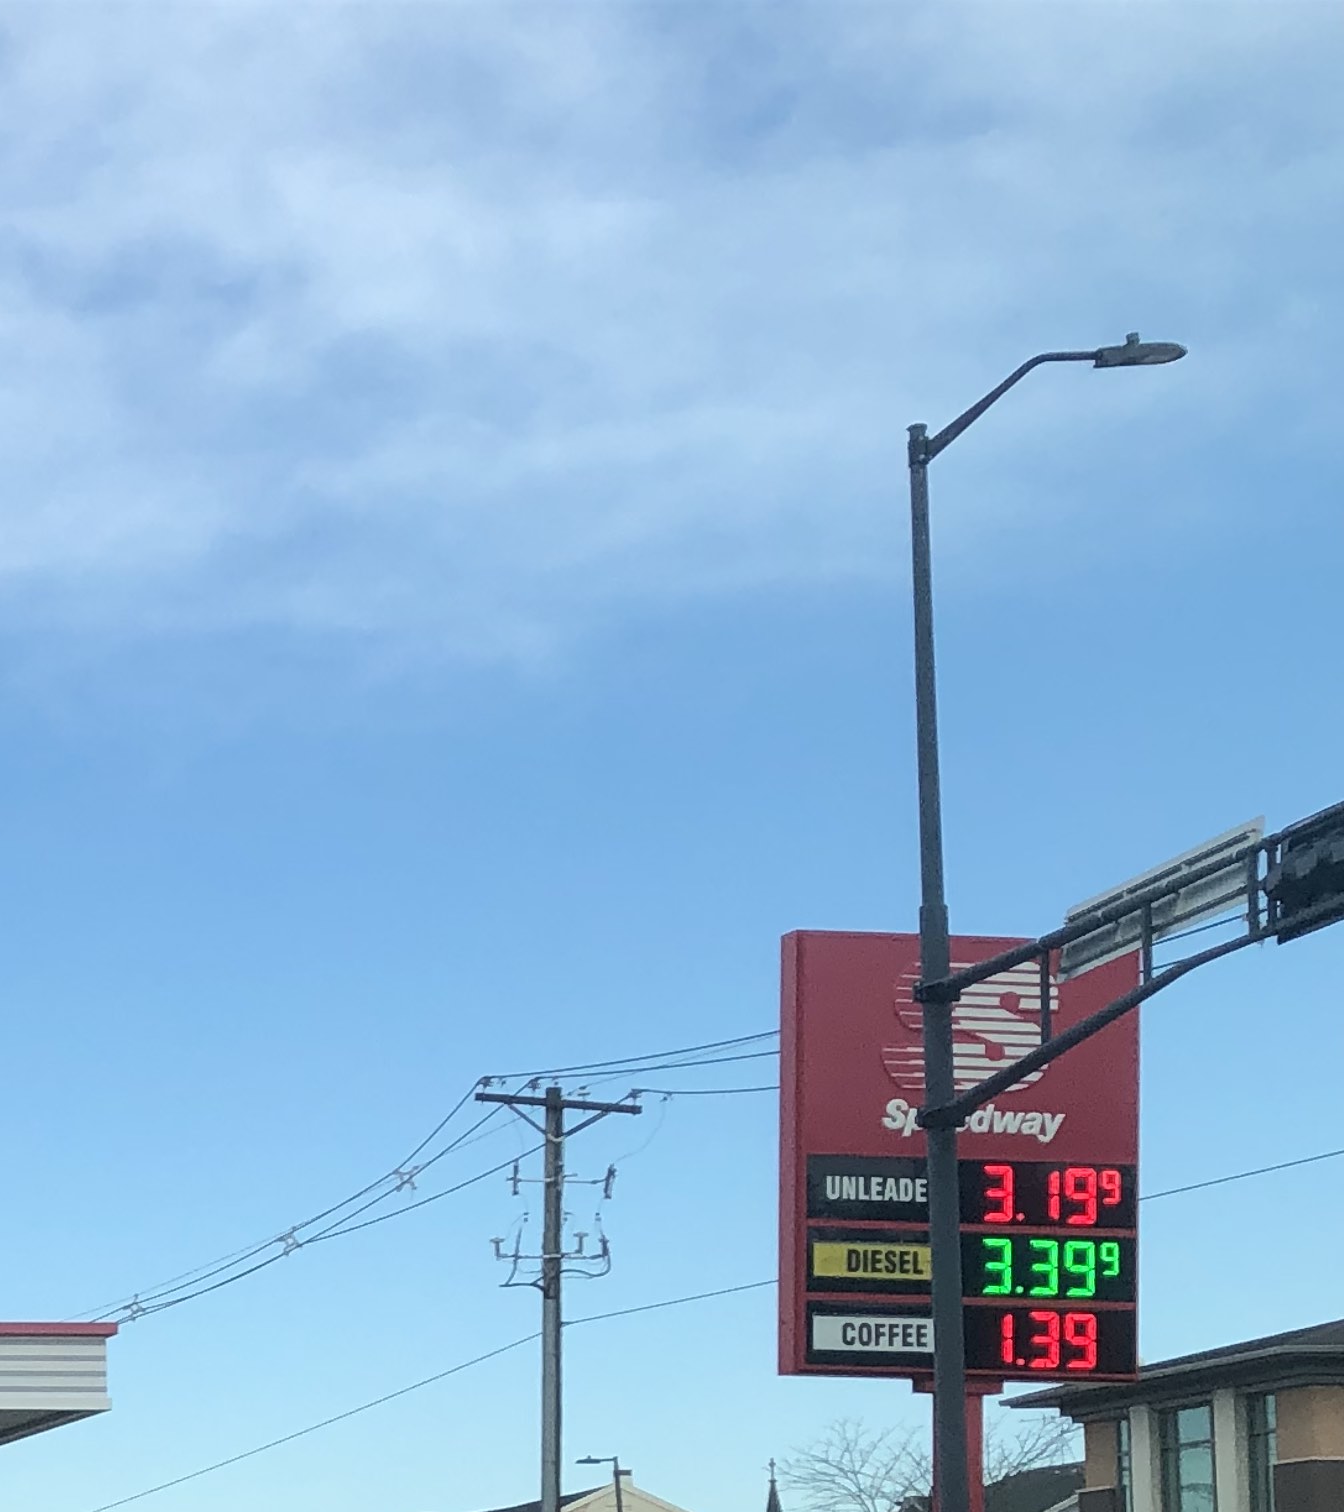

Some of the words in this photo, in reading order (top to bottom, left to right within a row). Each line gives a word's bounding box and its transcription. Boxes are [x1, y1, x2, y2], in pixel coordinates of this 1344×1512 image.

[882, 1098, 1066, 1143] Spdway
[825, 1175, 928, 1203] UNLEADE
[846, 1248, 925, 1275] DIESEL
[841, 1322, 928, 1347] COFFEE
[1000, 1311, 1098, 1370] 1.39
